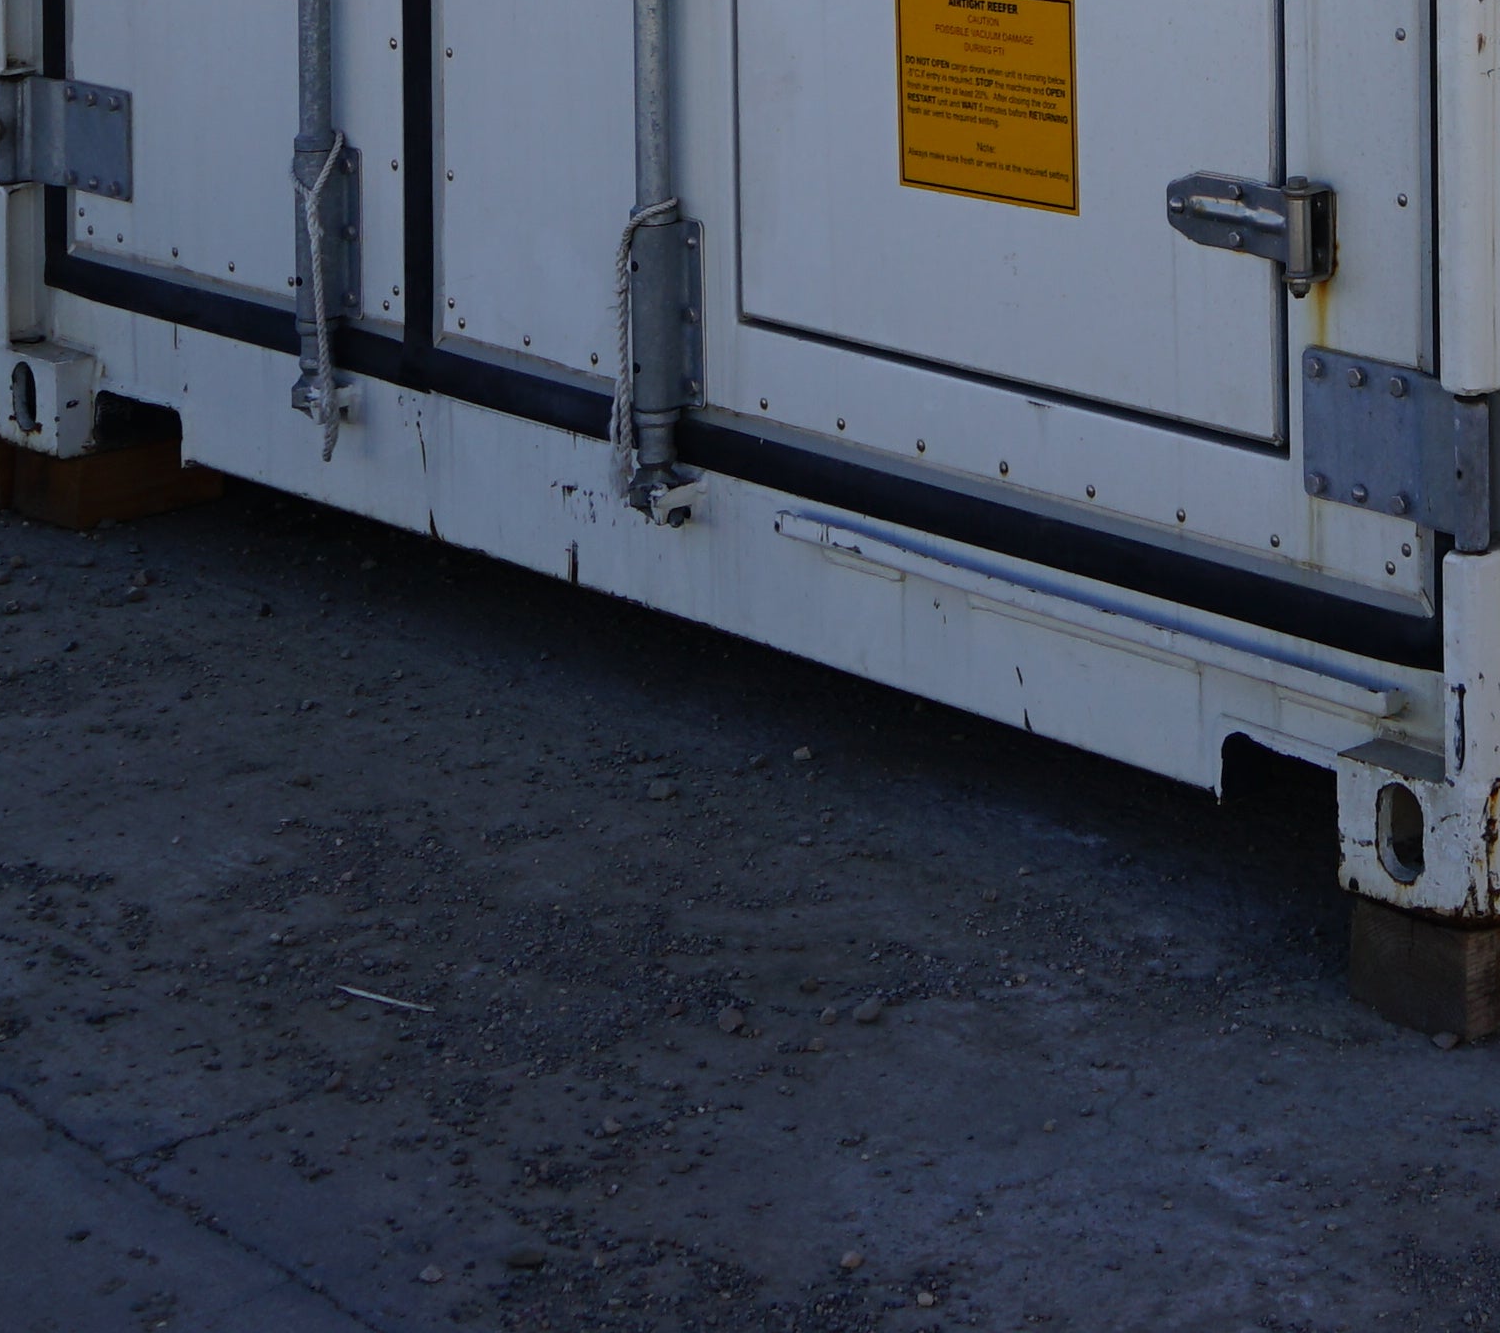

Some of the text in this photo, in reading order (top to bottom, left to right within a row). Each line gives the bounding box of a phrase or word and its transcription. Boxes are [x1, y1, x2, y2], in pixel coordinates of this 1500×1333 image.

[987, 0, 1018, 15] REEFER
[967, 15, 999, 27] CAUTION
[935, 24, 1034, 46] POSSIBLE VACUUM DAMAGE
[964, 42, 992, 55] DURING
